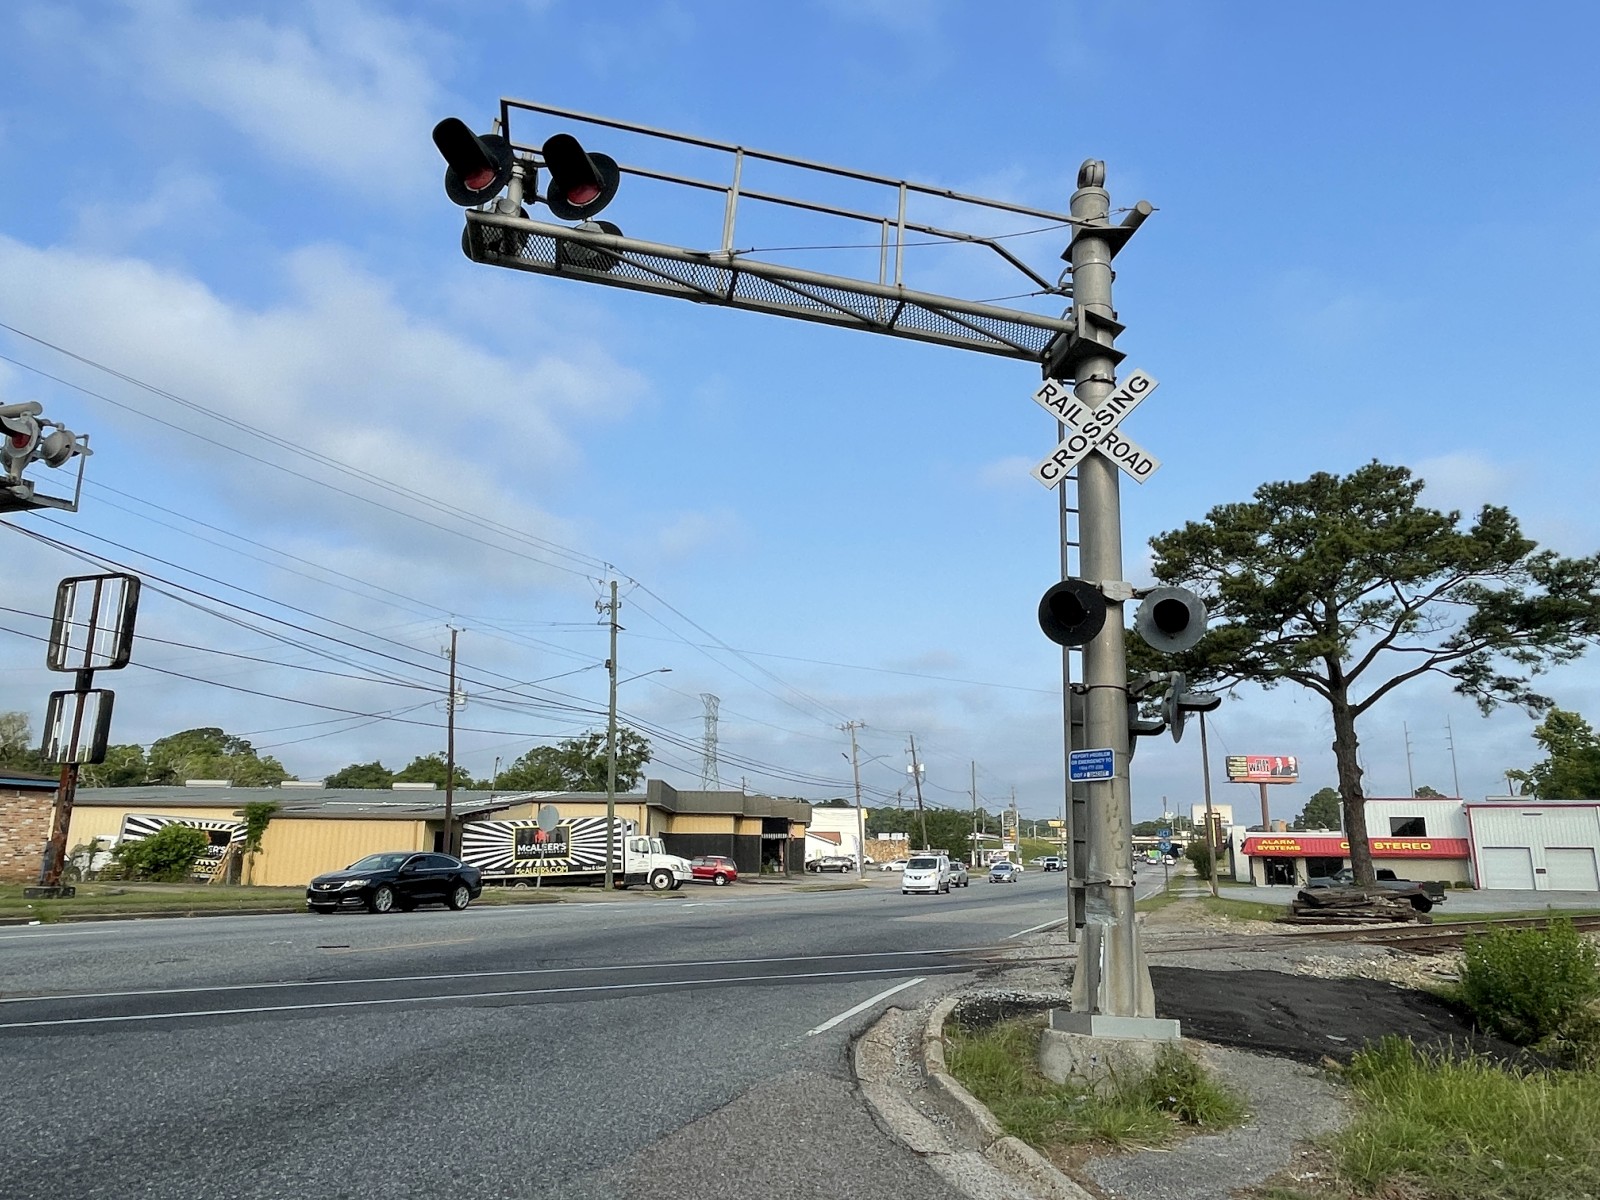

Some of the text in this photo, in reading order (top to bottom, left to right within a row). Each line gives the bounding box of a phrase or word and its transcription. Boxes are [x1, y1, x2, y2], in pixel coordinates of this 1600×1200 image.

[1037, 383, 1153, 476] RAIL ROAD
[1040, 375, 1150, 480] CROSSING
[1374, 842, 1432, 850] STEREO
